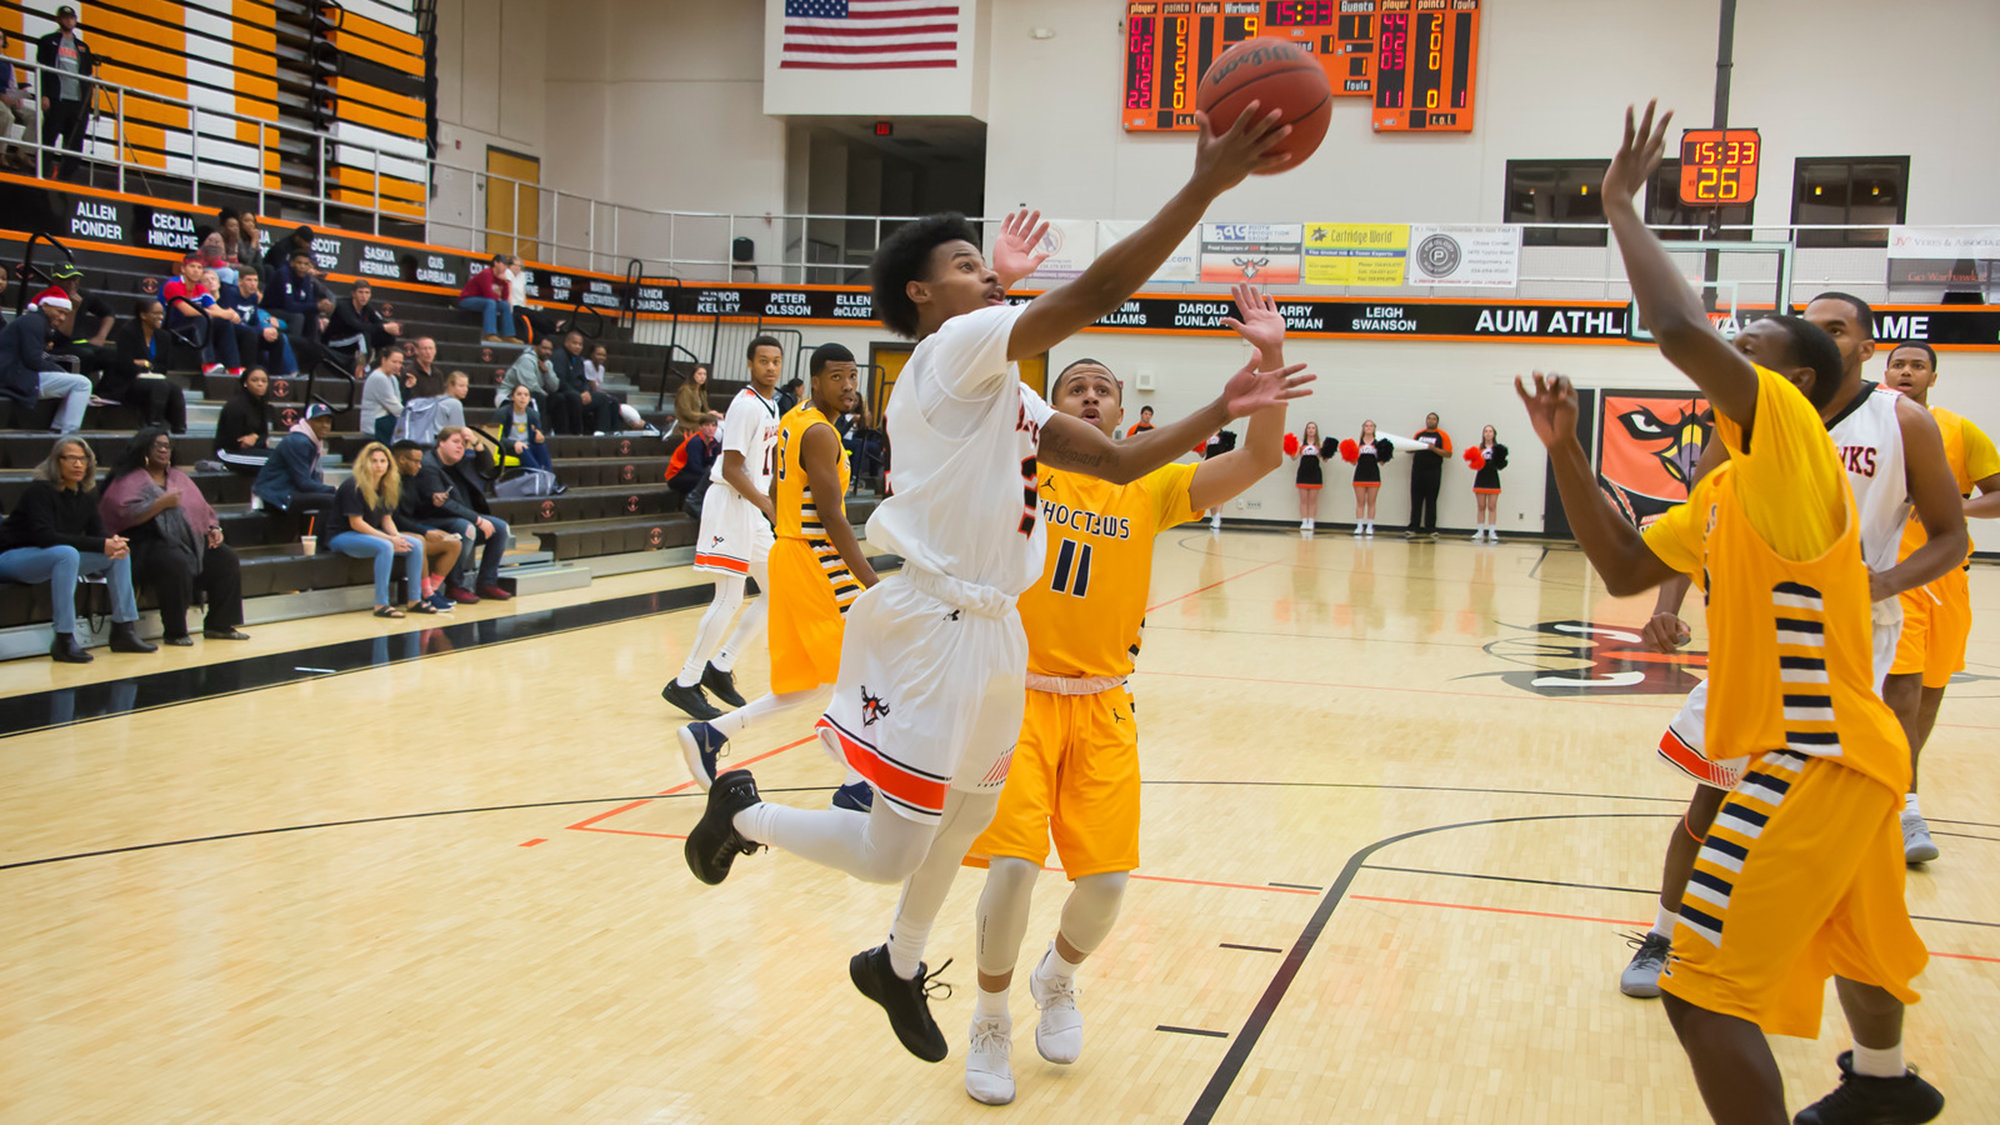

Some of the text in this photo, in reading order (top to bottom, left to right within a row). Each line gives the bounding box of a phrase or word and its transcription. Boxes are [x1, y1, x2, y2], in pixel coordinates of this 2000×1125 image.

[1130, 3, 1156, 14] player
[1164, 3, 1189, 13] points
[1197, 3, 1218, 13] fouls
[1276, 1, 1331, 25] 15:33
[1341, 1, 1374, 12] Guests
[1382, 0, 1408, 10] player
[1418, 0, 1444, 9] points
[1131, 17, 1188, 35] 01 0
[1244, 17, 1259, 40] 9
[1354, 15, 1374, 38] 11
[1383, 13, 1443, 31] 44 2
[1130, 35, 1186, 53] 02 5
[1382, 32, 1442, 50] 02 0
[1136, 54, 1186, 72] 10 2
[1381, 51, 1440, 70] 03 0
[1135, 73, 1185, 90] 12 2
[1346, 80, 1369, 91] fouls
[1128, 90, 1184, 109] 22 0
[1385, 90, 1402, 107] 11
[1426, 89, 1438, 108] 0
[1695, 142, 1755, 165] 15:33
[1698, 168, 1737, 199] 26
[76, 201, 117, 221] ALLEN
[71, 218, 123, 240] PONDER
[151, 213, 195, 233] CECILIA
[148, 229, 200, 251] HINCAPIE
[1331, 229, 1392, 245] Cartridge World
[311, 238, 342, 254] SCOTT
[364, 246, 396, 263] SASKIA
[359, 259, 400, 279] HERMANS
[428, 256, 445, 270] GUS
[416, 268, 456, 285] GARIBALDI
[551, 275, 572, 289] HEATH
[770, 293, 806, 304] PETER
[836, 295, 872, 306] ELLEN
[697, 302, 741, 313] KELLEY
[765, 304, 811, 316] OLSSON
[833, 307, 872, 318] deCLOUET
[1120, 302, 1140, 313] JIM
[1178, 303, 1229, 315] DAROLD
[1278, 306, 1312, 317] ARRY
[1366, 307, 1403, 318] LEIGH
[1351, 319, 1417, 331] SWANSON
[1474, 310, 1538, 333] AUM
[1050, 537, 1092, 599] 11
